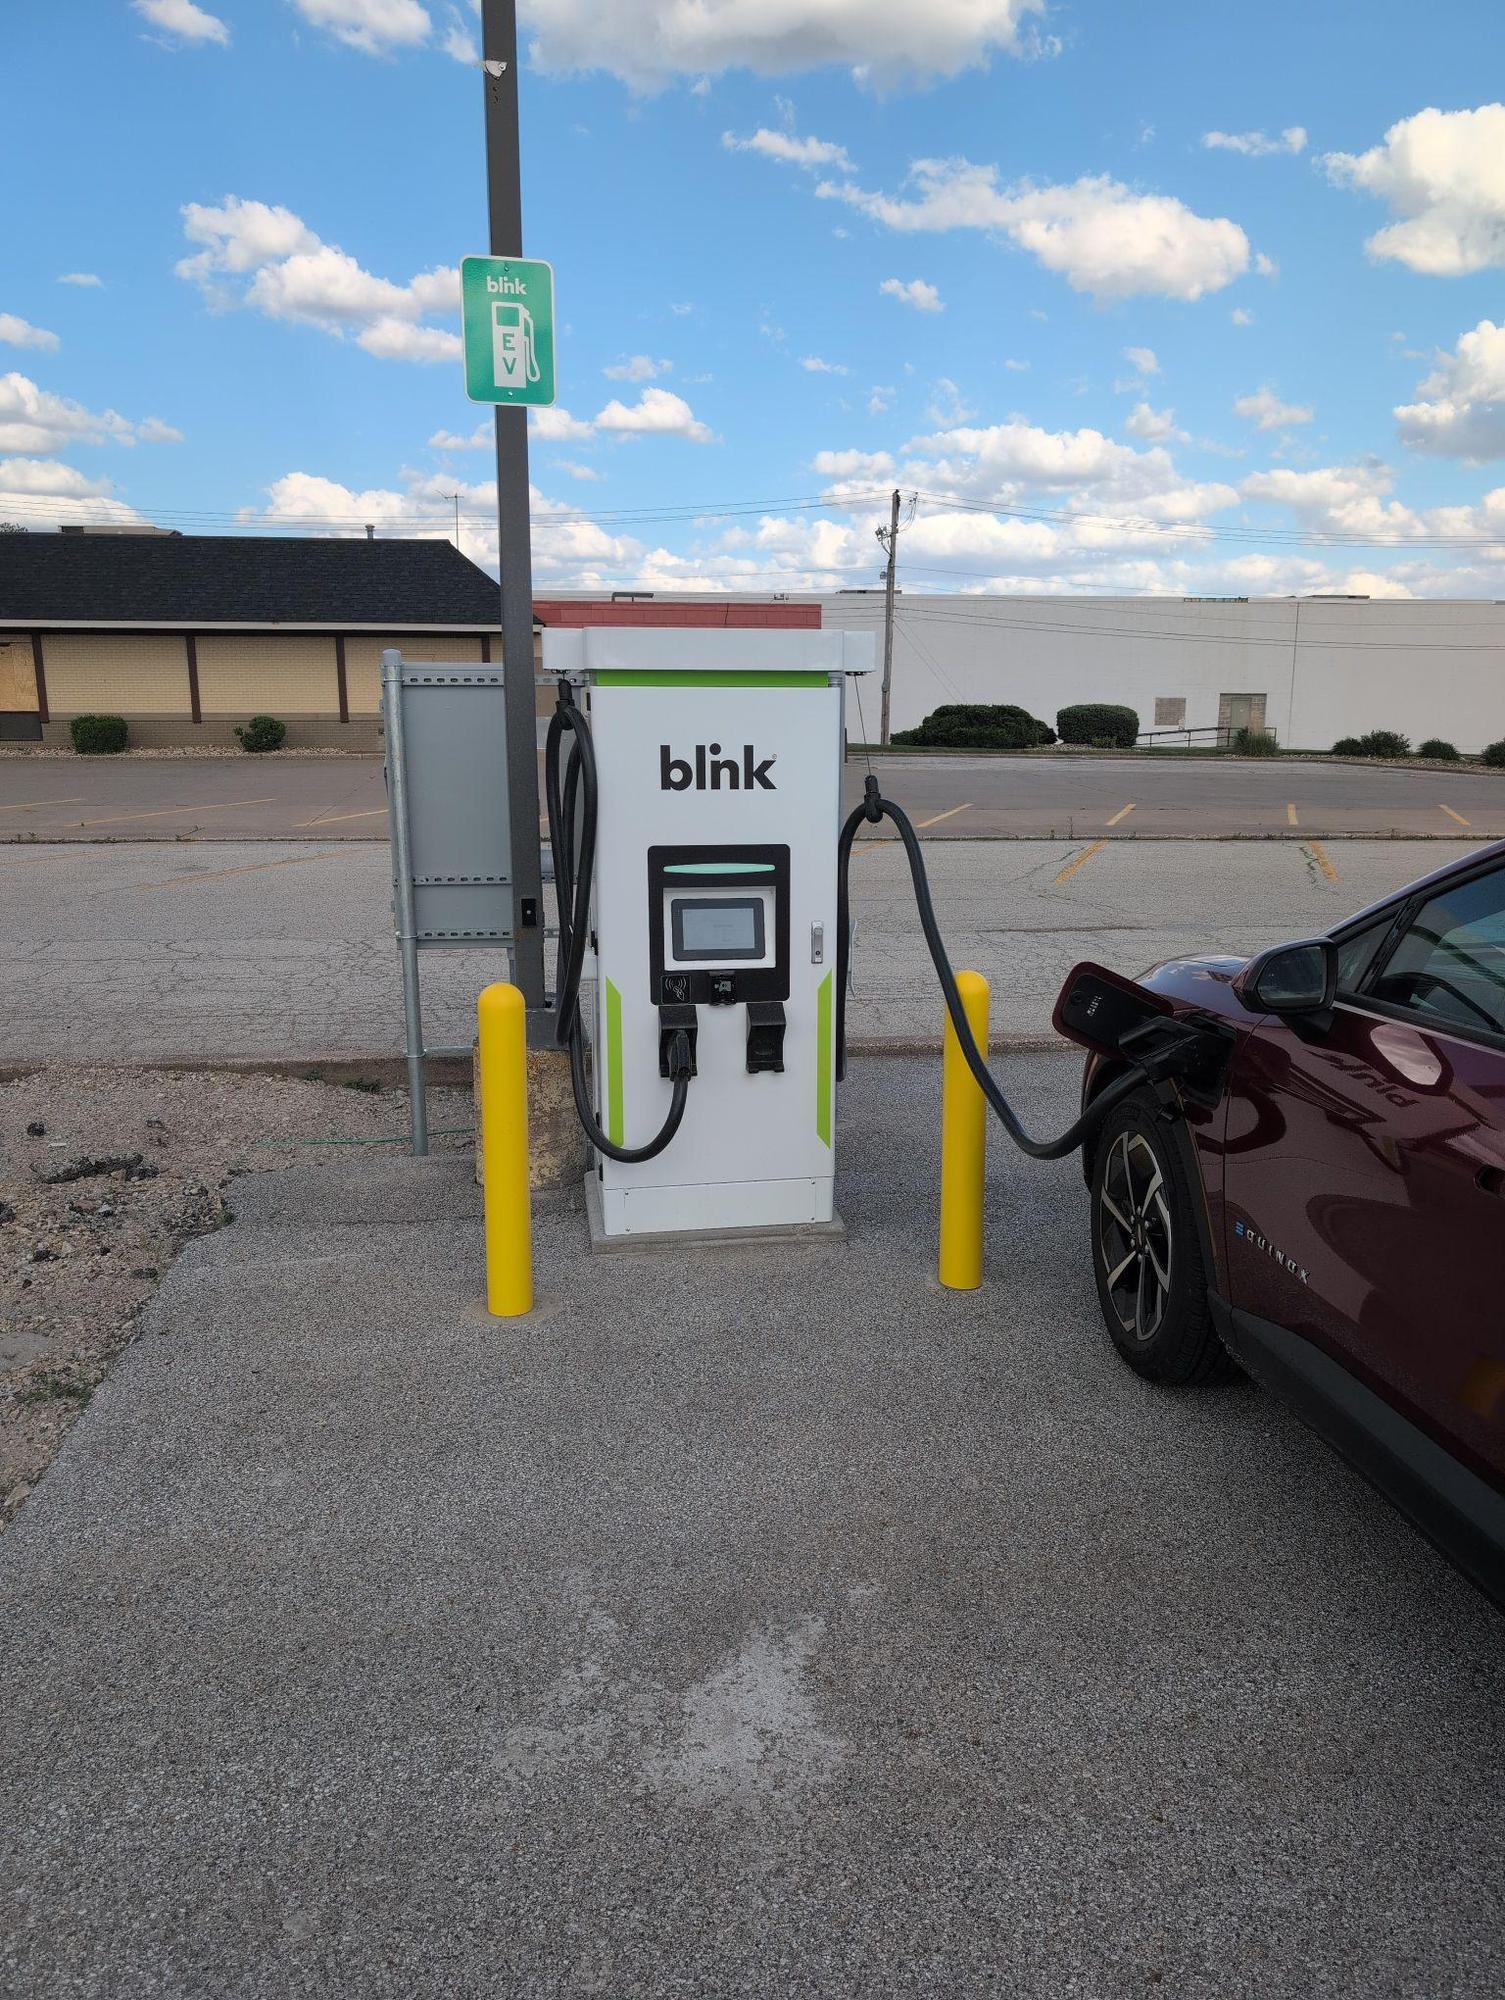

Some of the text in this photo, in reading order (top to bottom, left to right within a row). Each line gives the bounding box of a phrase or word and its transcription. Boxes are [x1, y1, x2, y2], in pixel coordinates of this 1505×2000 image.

[486, 275, 527, 295] blink
[660, 743, 778, 791] blink
[1235, 1221, 1309, 1284] EQUINOX
